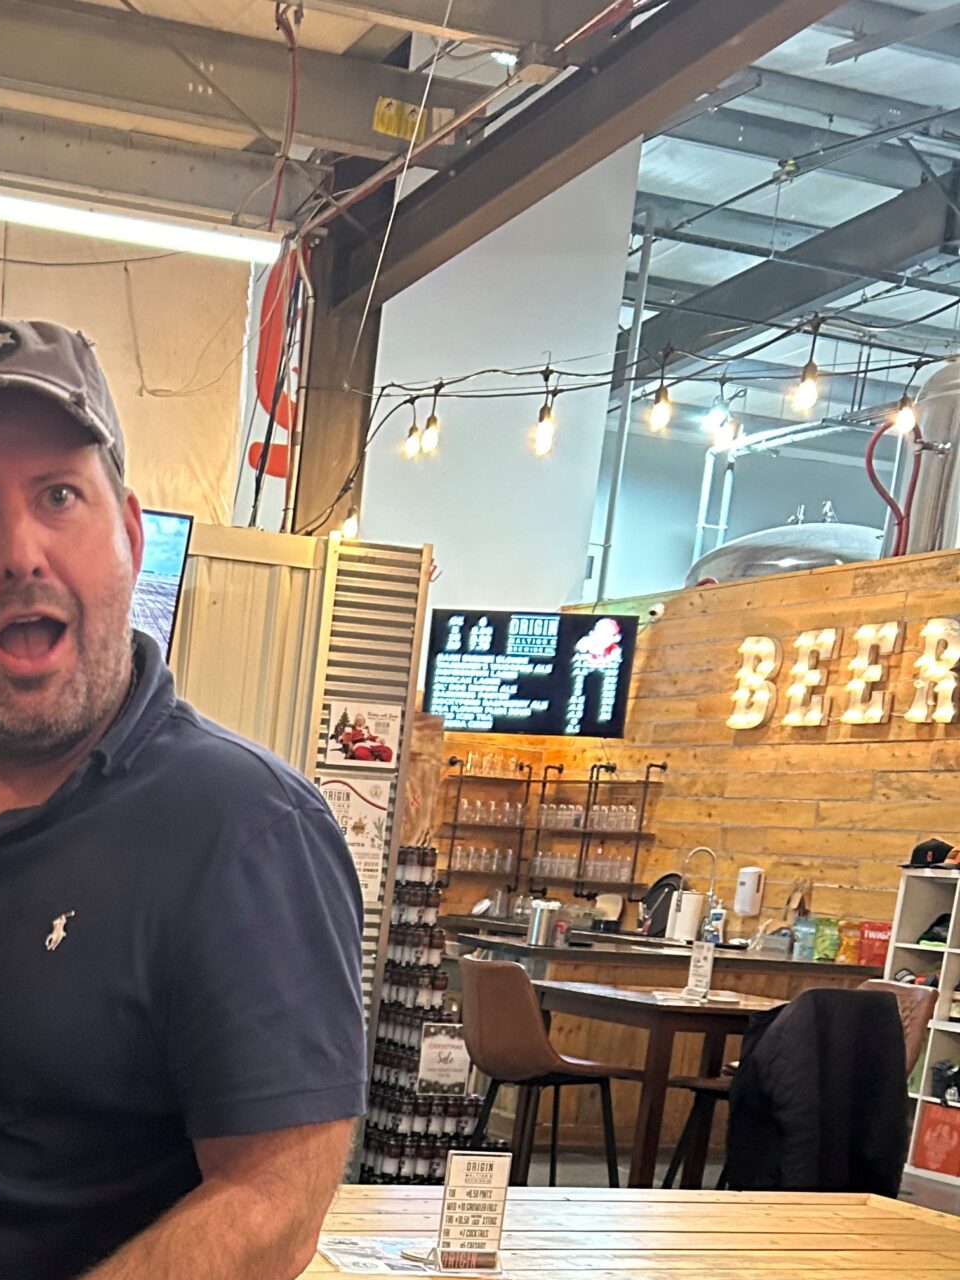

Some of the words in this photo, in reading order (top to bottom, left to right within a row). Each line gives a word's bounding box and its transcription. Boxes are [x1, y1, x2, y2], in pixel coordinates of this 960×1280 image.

[509, 619, 559, 635] ORIGIN
[726, 618, 960, 730] BEER
[466, 1161, 494, 1172] ORIGIN
